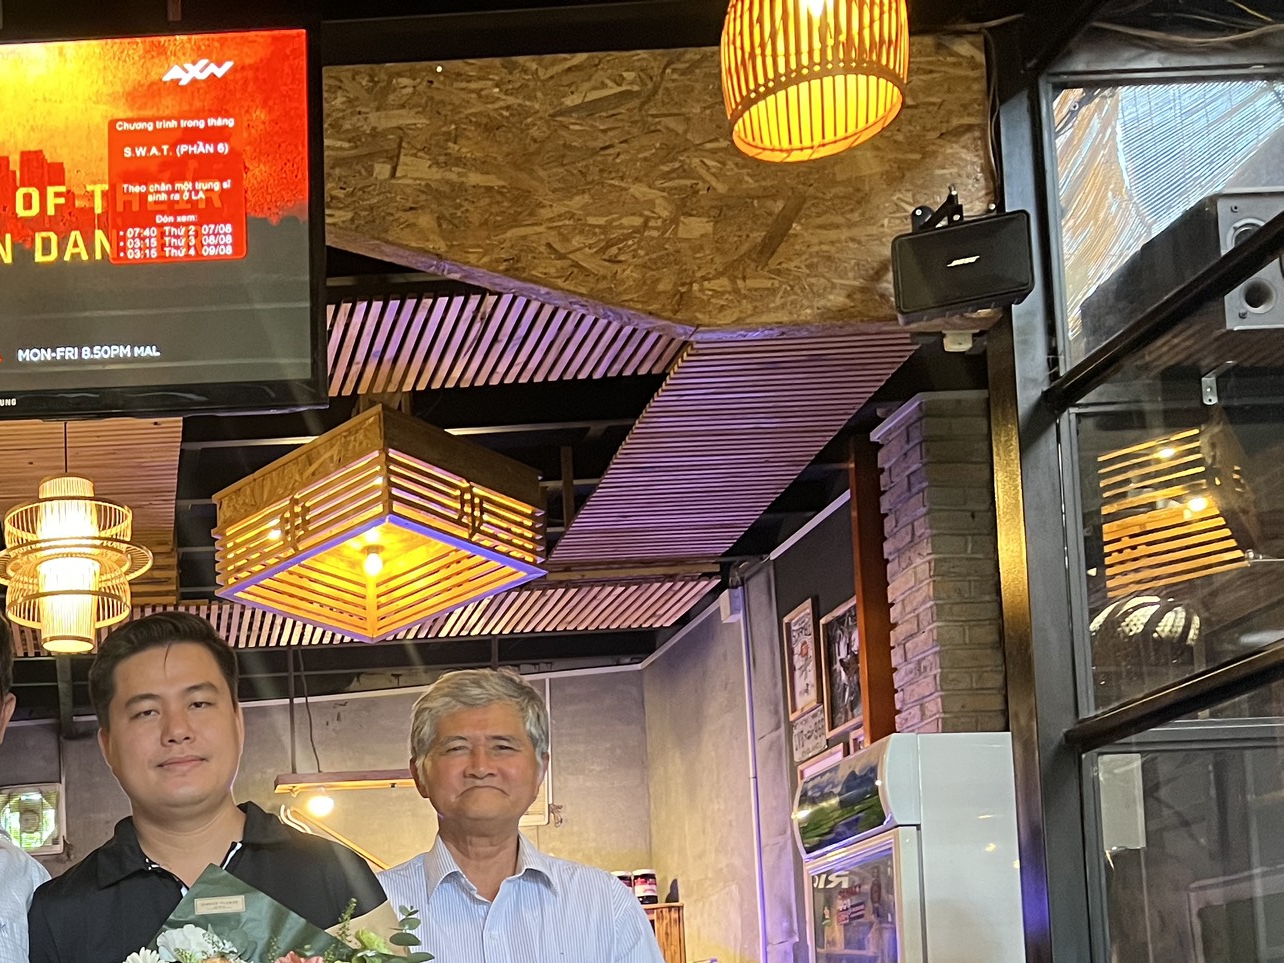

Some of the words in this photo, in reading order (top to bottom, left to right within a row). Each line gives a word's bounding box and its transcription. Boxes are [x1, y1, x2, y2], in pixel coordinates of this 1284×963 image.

[162, 59, 234, 86] AXN
[180, 119, 205, 129] trong
[122, 183, 147, 194] Theo
[195, 180, 221, 191] trung
[15, 185, 66, 218] OF
[191, 191, 206, 200] LA
[126, 226, 158, 238] 07:40
[188, 226, 196, 236] 2
[201, 223, 233, 235] 07/08
[188, 236, 196, 246] 3
[188, 246, 196, 257] 4
[17, 347, 79, 362] MON-FRI
[81, 345, 131, 360] 8.50PM
[134, 345, 161, 358] MAL
